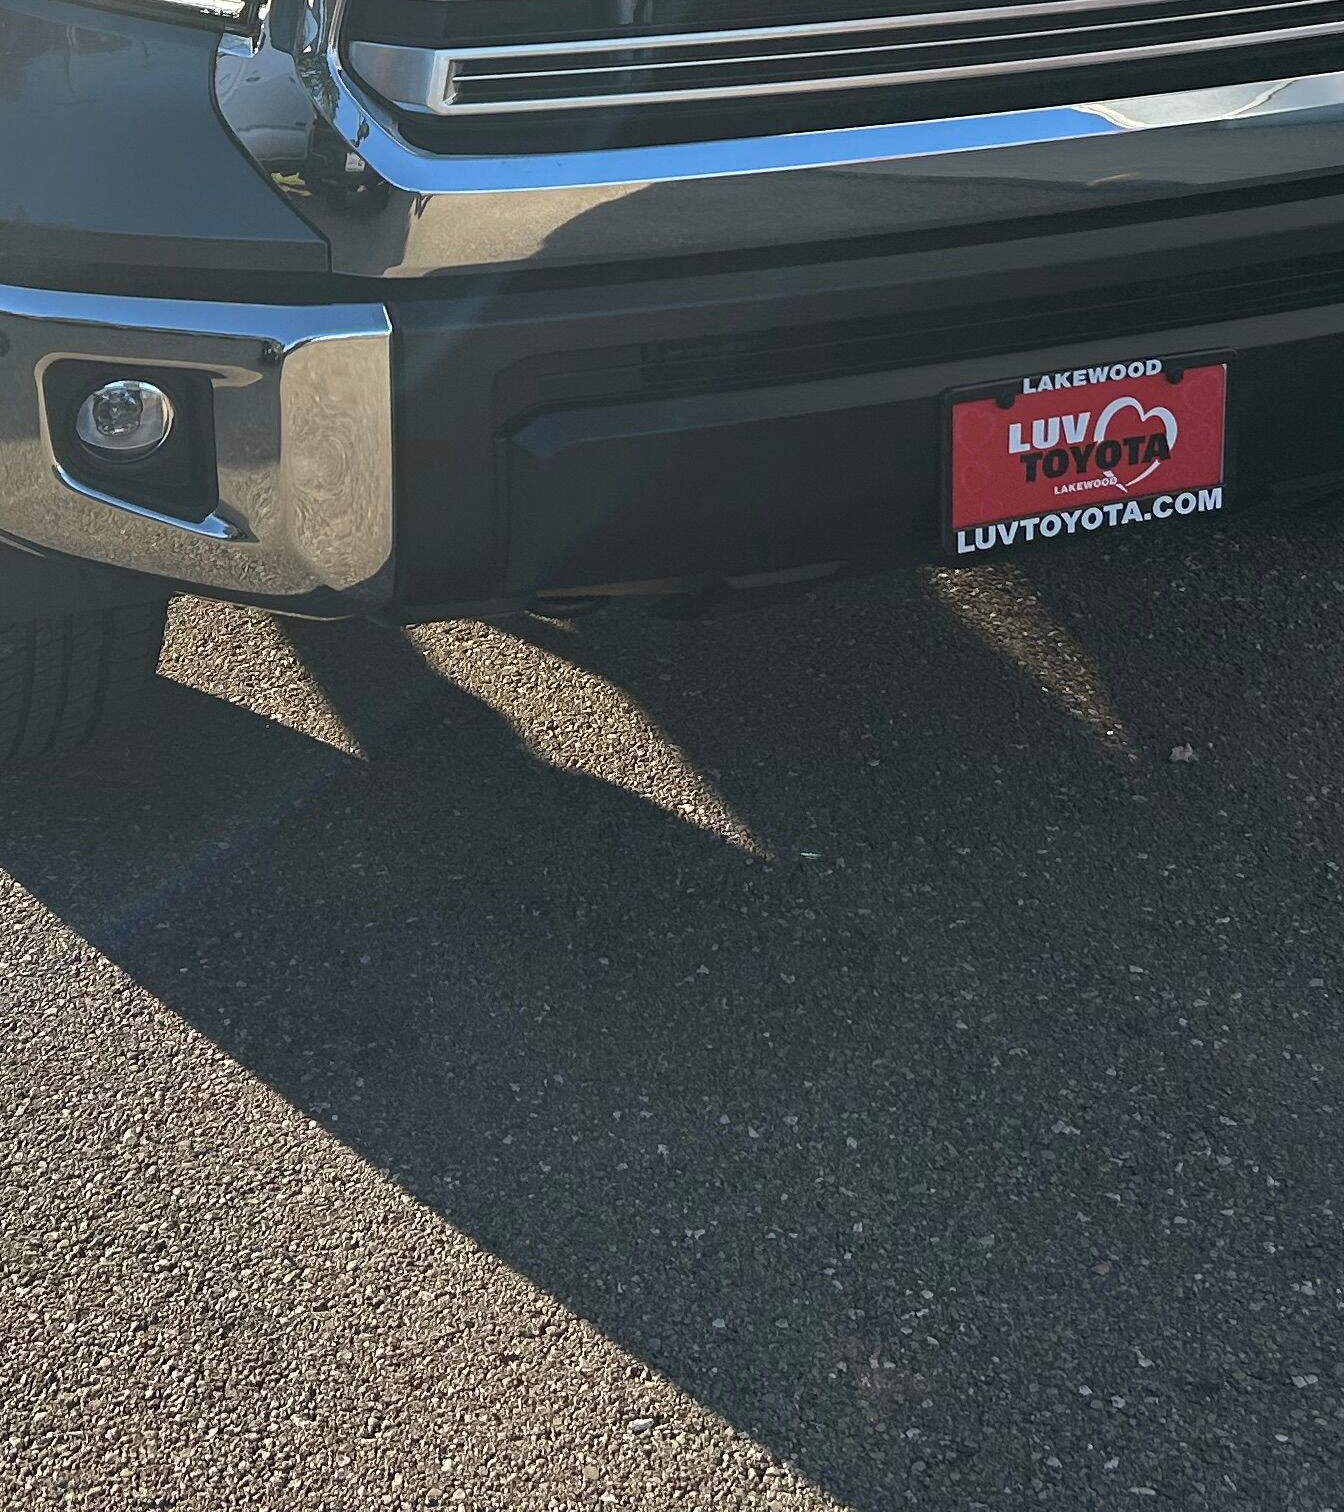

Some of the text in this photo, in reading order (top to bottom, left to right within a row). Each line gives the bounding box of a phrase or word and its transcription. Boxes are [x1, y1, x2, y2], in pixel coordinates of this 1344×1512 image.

[1022, 359, 1163, 395] LAKEWOOD
[1008, 411, 1091, 454] LUV
[1020, 433, 1171, 483] TOYOTA
[1053, 476, 1119, 495] LAKEWOOD
[957, 487, 1223, 554] LUVTOYOTA.COM
